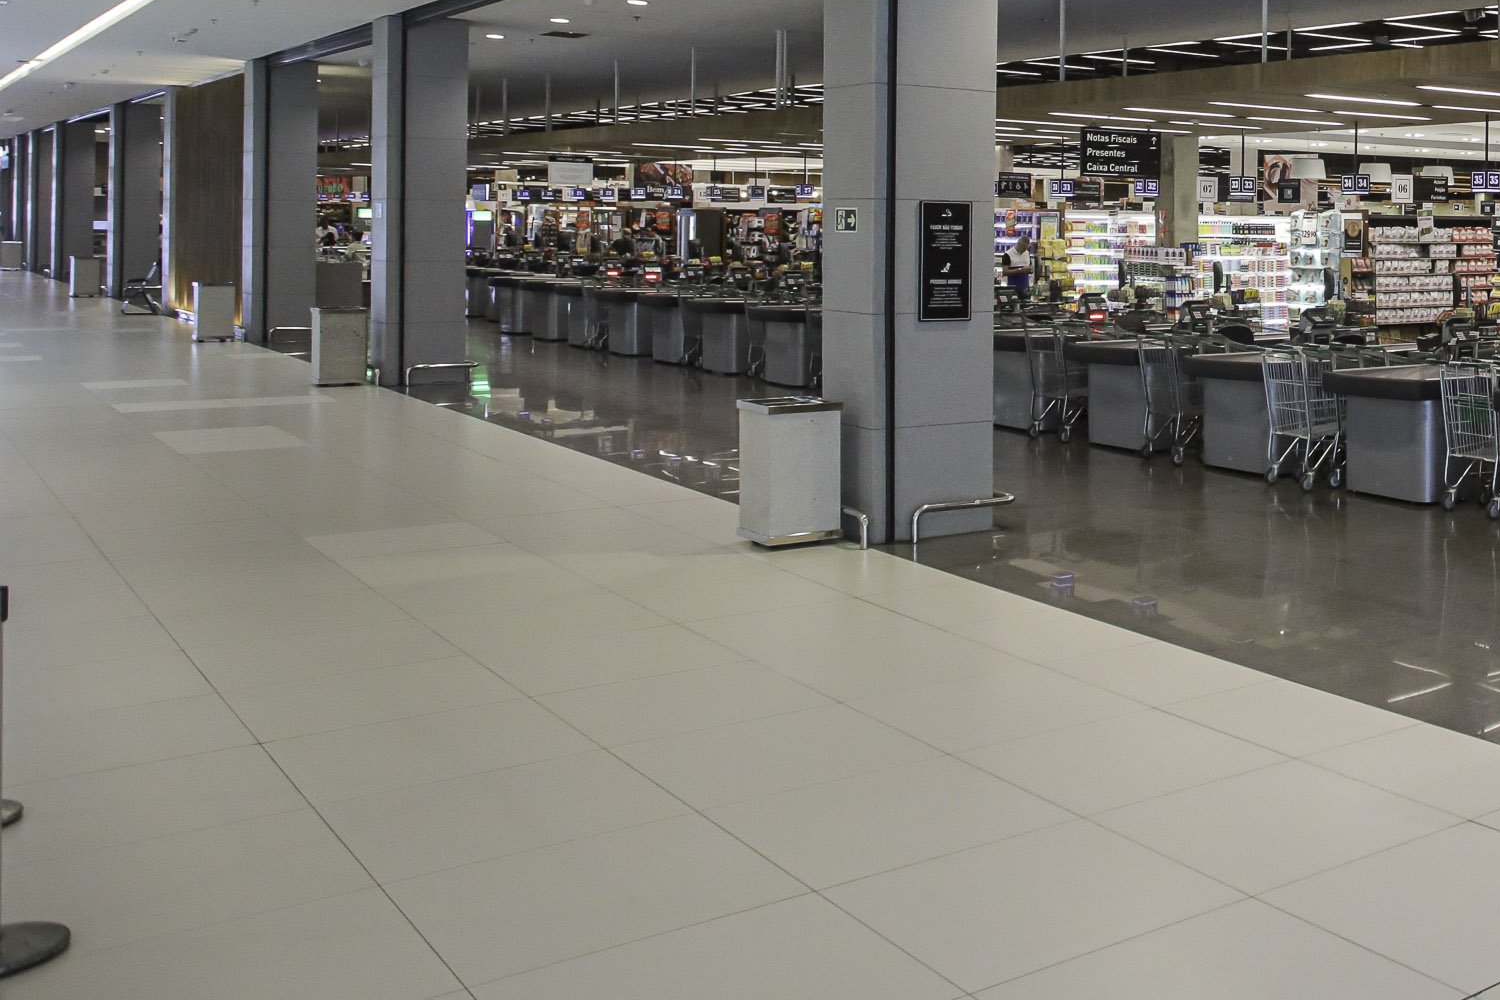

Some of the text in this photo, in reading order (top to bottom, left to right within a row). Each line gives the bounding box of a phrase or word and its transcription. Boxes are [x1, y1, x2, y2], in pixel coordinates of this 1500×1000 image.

[1086, 133, 1138, 144] Notas Fiscais
[1086, 148, 1126, 158] Presentes
[1086, 162, 1138, 173] Caixa Central
[1244, 181, 1253, 189] 33
[1358, 178, 1367, 188] 34
[1474, 175, 1483, 185] 35
[1489, 175, 1499, 185] 35
[1062, 183, 1072, 191] 31
[1147, 182, 1157, 190] 32
[1202, 185, 1213, 194] 07
[1397, 184, 1408, 194] 06
